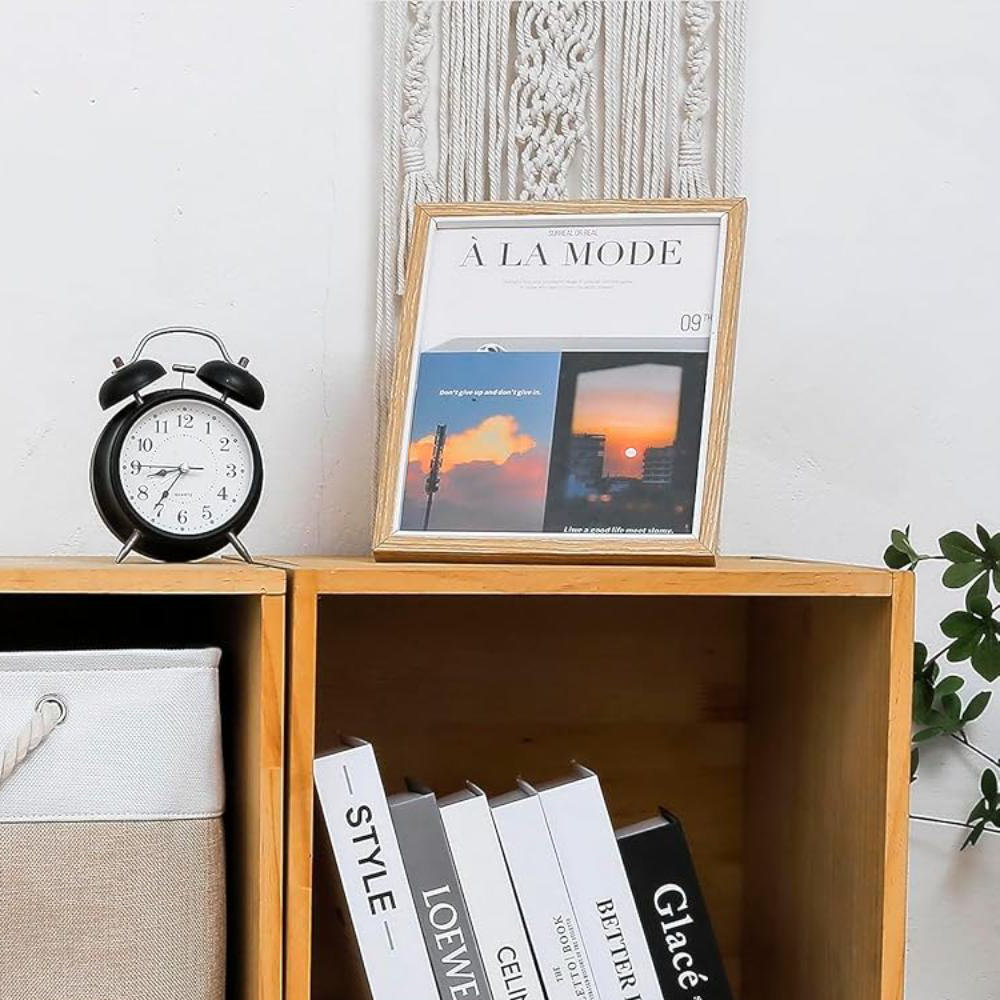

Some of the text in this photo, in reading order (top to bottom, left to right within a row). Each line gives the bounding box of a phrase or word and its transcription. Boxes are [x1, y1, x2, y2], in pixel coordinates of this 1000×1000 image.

[459, 235, 683, 268] À LA MODE
[155, 420, 169, 434] 11
[177, 414, 194, 429] 12
[205, 422, 211, 435] 1
[138, 438, 153, 453] 10
[219, 437, 230, 452] 2
[130, 460, 141, 475] 9
[226, 463, 237, 478] 3
[137, 485, 149, 500] 8
[217, 487, 228, 501] 4
[154, 504, 165, 517] 7
[177, 510, 188, 524] 6
[202, 505, 213, 520] 5
[346, 805, 396, 915] STYLE
[553, 915, 572, 953] BOOK
[654, 883, 709, 990] Glacé
[596, 898, 637, 991] BETTER
